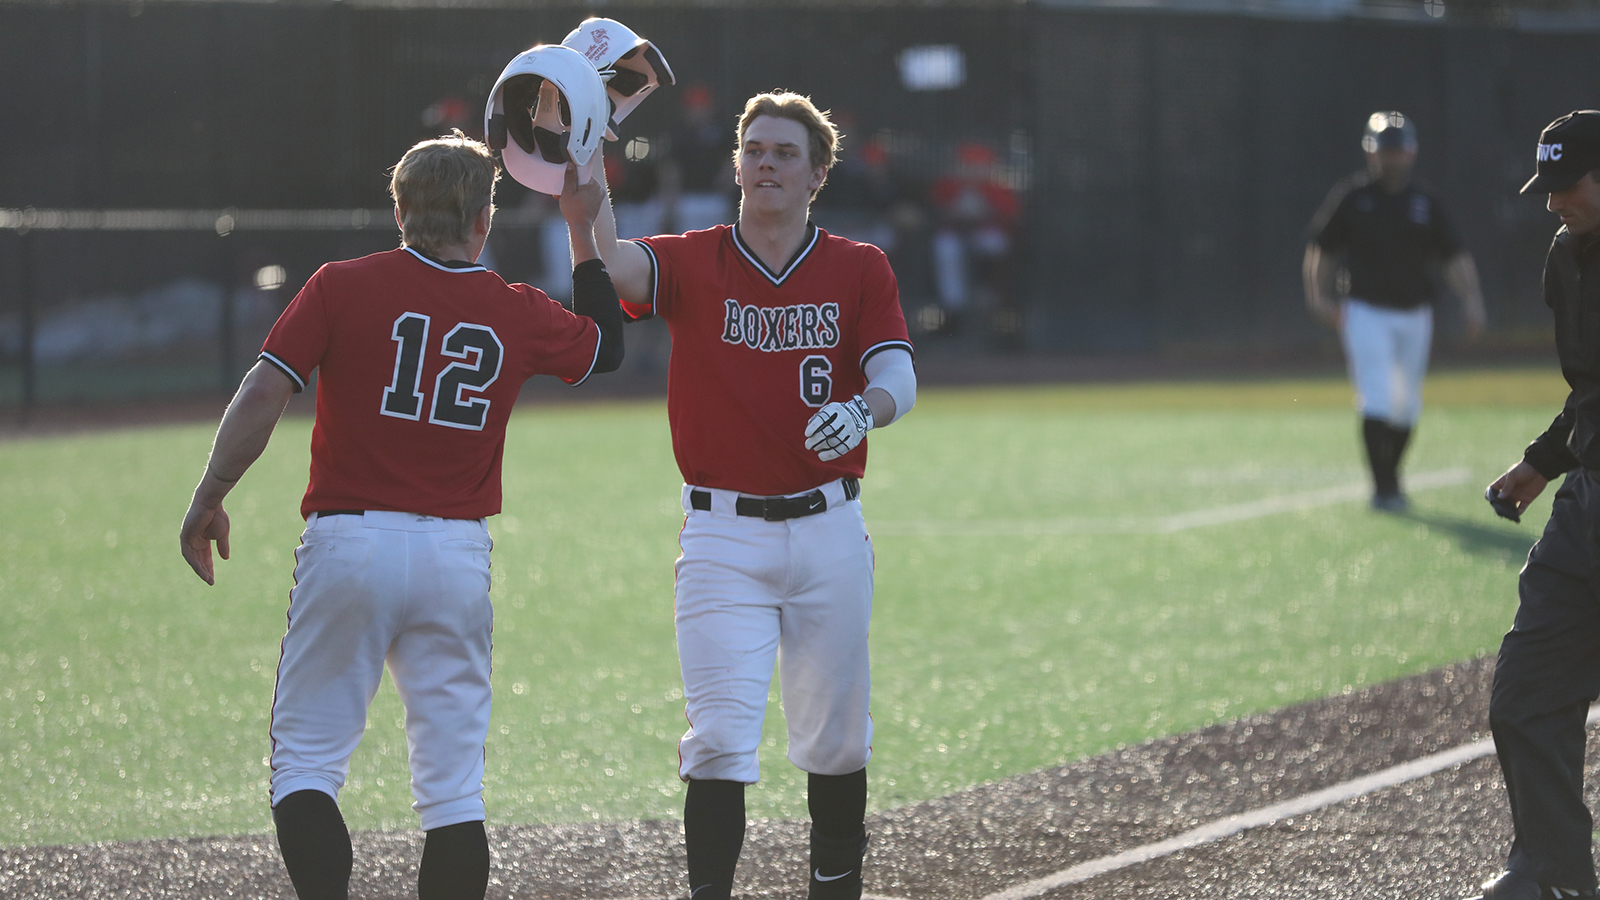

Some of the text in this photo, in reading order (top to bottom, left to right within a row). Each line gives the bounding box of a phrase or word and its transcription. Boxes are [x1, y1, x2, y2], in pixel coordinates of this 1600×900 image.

[585, 44, 597, 56] acific
[588, 41, 608, 60] niversity
[1538, 143, 1562, 161] WC
[721, 299, 840, 352] BOXERS
[380, 311, 504, 431] 12
[799, 355, 832, 407] 6
